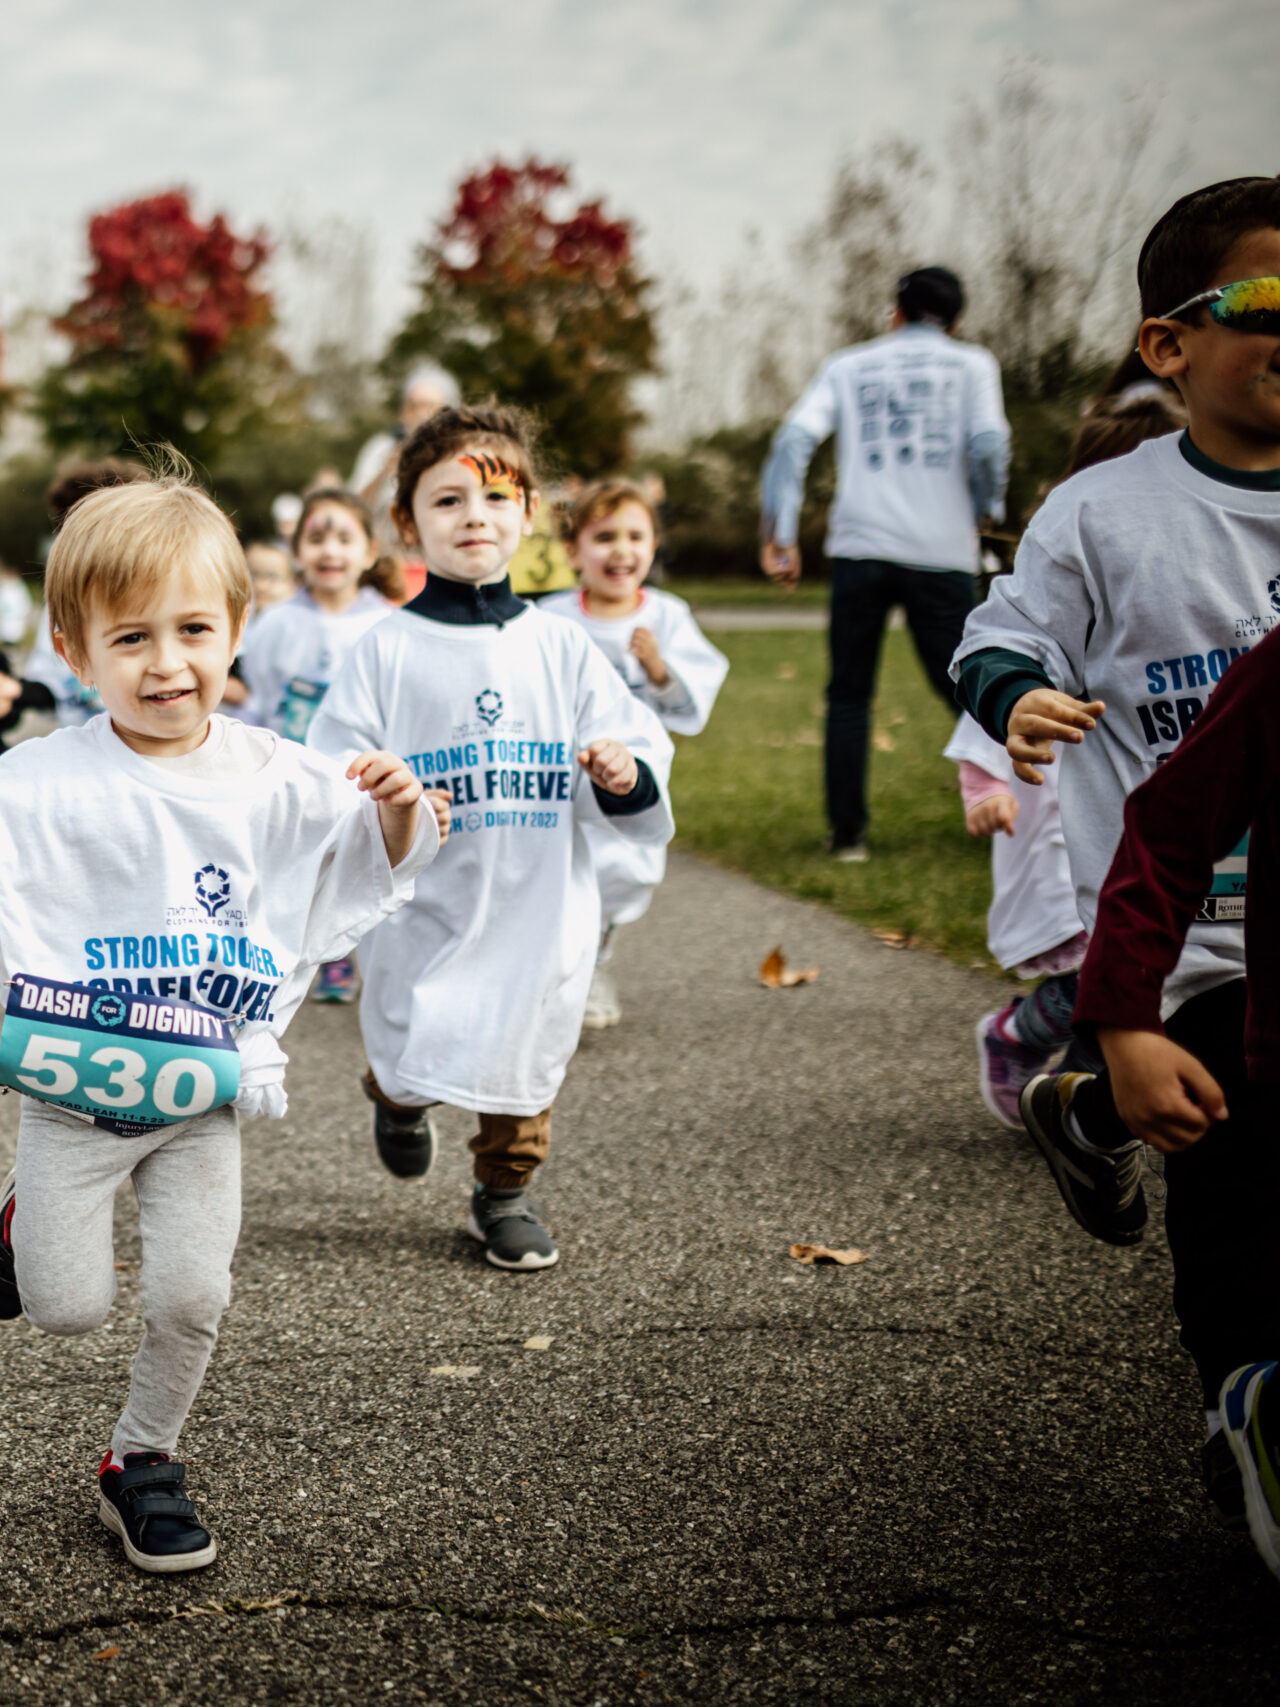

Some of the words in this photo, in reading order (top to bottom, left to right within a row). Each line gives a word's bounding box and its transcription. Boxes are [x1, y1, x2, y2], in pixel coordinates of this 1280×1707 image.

[1235, 627, 1273, 638] CLOTH
[1136, 694, 1211, 746] ISR
[403, 743, 479, 777] TRONG
[483, 739, 572, 765] TOGETHE
[485, 769, 574, 802] FOREVE
[84, 933, 200, 970] STRONG
[20, 982, 90, 1020] DASH
[100, 1005, 117, 1014] FOR
[129, 1002, 225, 1040] DIGNITY
[16, 1033, 217, 1117] 530
[60, 1100, 82, 1110] YAD
[86, 1106, 118, 1117] LEAH
